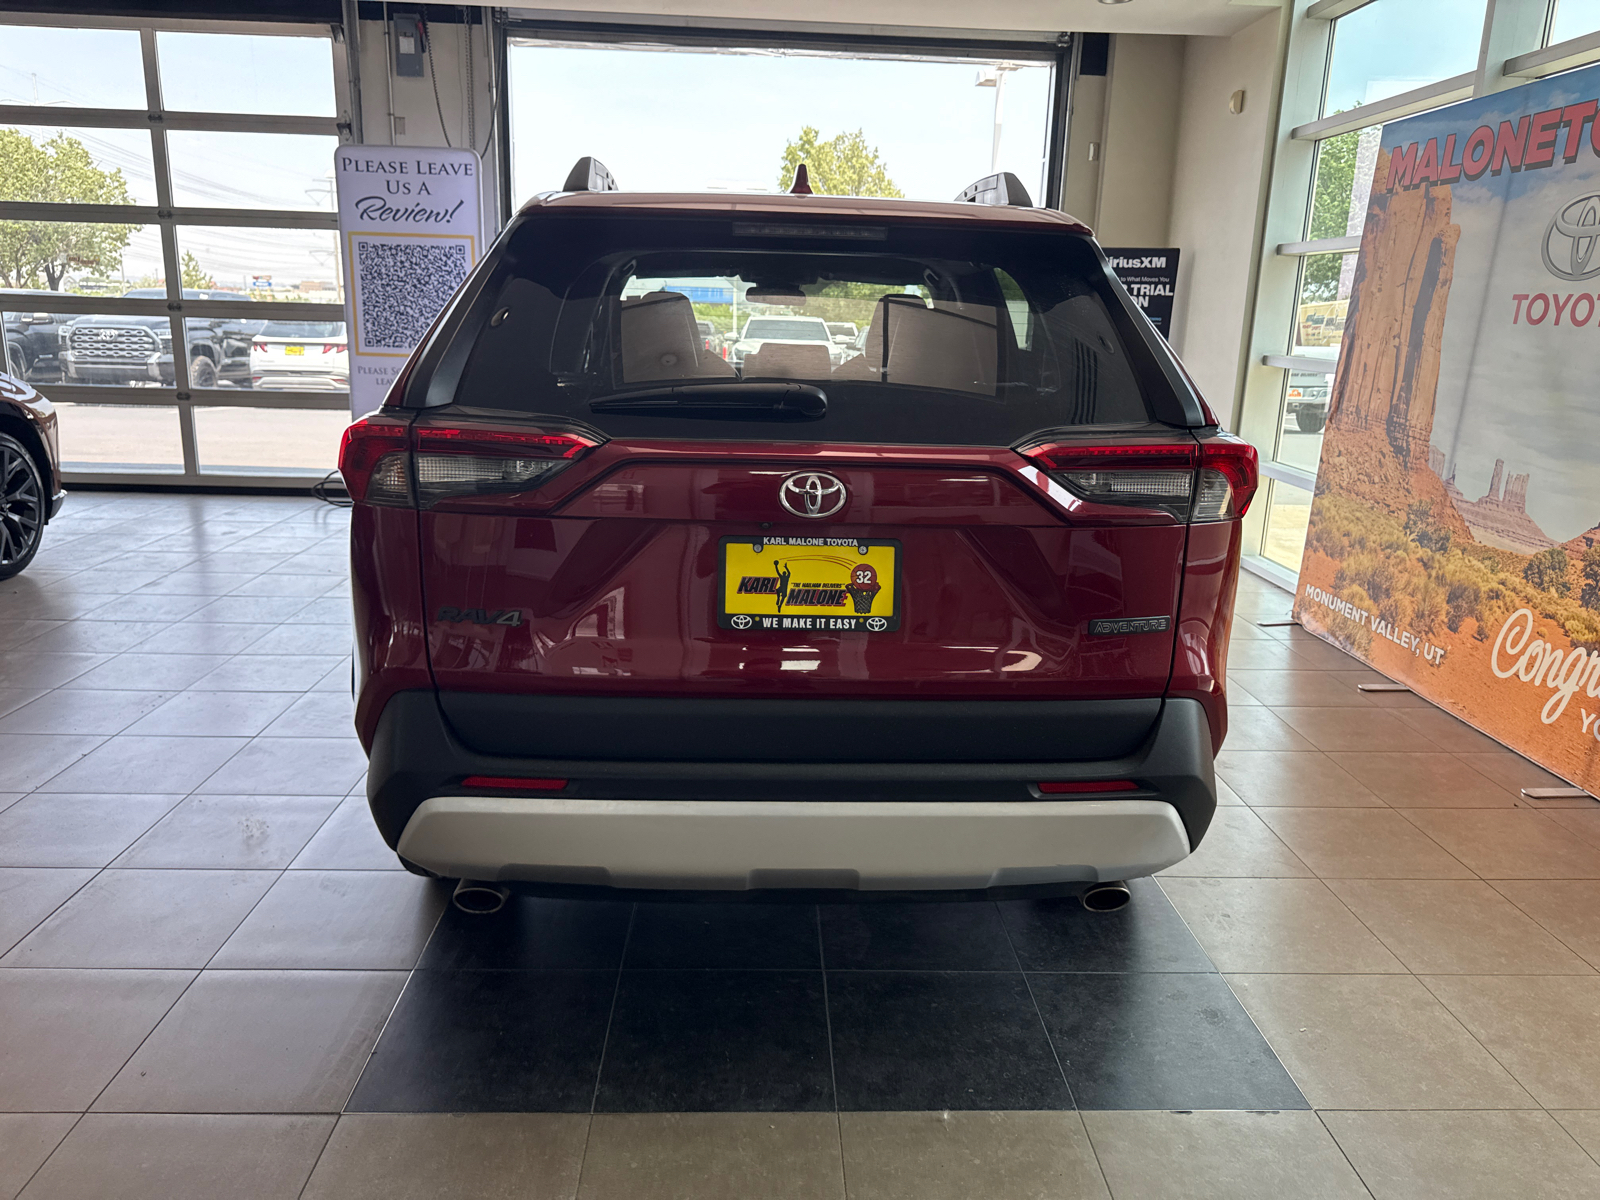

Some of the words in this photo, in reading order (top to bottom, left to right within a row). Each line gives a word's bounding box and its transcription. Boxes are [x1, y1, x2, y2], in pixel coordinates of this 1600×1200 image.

[1386, 98, 1600, 194] MALONET
[342, 157, 408, 175] PLEASE
[416, 160, 473, 177] LEAVE
[385, 180, 412, 195] US
[418, 181, 432, 195] A
[355, 195, 464, 224] Review!
[1108, 256, 1166, 268] iriusXM
[1131, 284, 1174, 296] TRIAL
[1512, 293, 1600, 327] TOYO
[357, 366, 389, 375] PLEASE
[375, 378, 396, 386] LEAV
[763, 537, 787, 545] KARL
[788, 538, 825, 546] MALONE
[826, 538, 859, 547] TOYOTA
[737, 575, 779, 594] KARL
[856, 570, 872, 584] 32
[785, 588, 848, 607] MALONE
[437, 606, 523, 627] RAV4
[762, 617, 779, 628] WE
[782, 617, 812, 629] MAKE
[816, 619, 827, 629] IT
[829, 619, 856, 629] EASY
[1305, 583, 1368, 625] MONUMENT
[1371, 615, 1420, 657] VALLEY,
[1423, 642, 1445, 665] UT
[1094, 620, 1167, 633] ADVENTURE
[1491, 608, 1600, 724] Congr
